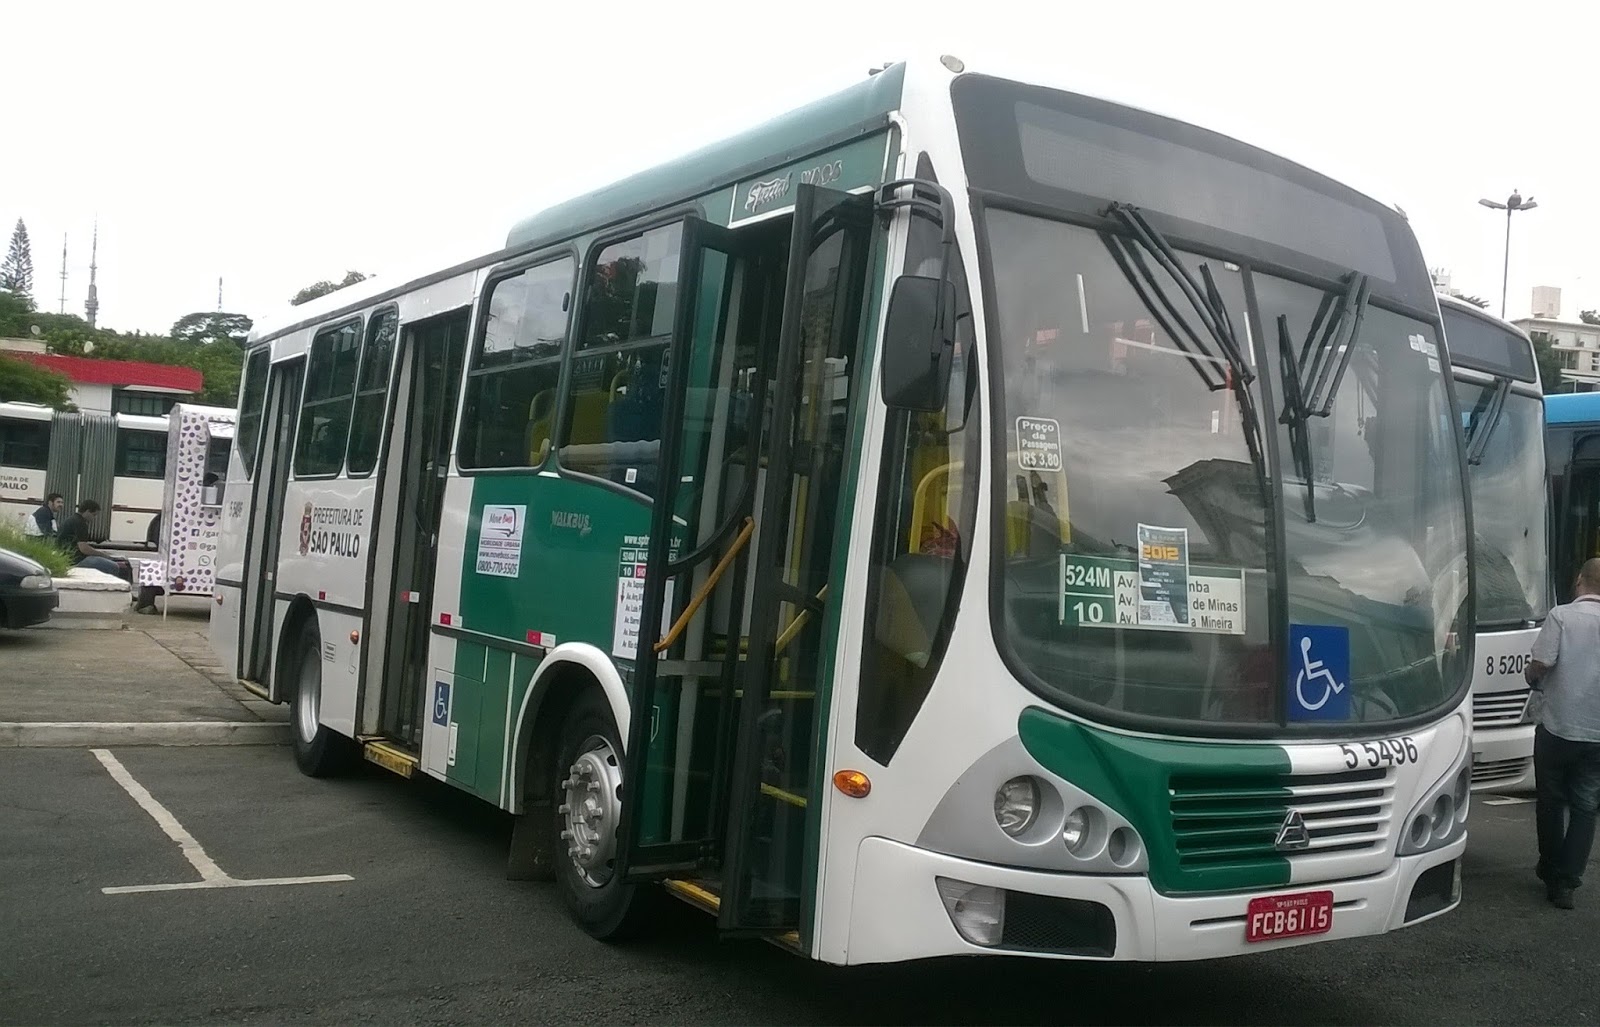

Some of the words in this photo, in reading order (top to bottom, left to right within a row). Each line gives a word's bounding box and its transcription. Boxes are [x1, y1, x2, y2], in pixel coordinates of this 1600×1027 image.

[1022, 420, 1054, 433] Preço
[1021, 438, 1058, 451] Passagem
[1022, 451, 1037, 467] R$
[1039, 452, 1059, 468] 3,80
[312, 506, 351, 526] PREFEITURA
[353, 508, 363, 526] DE
[311, 526, 328, 554] SÃO
[329, 532, 360, 558] PAULO
[1143, 544, 1179, 560] 2012
[623, 567, 632, 577] 10
[1065, 565, 1110, 588] 524M
[1117, 575, 1136, 589] Av.
[1118, 593, 1135, 607] Av.
[1192, 600, 1206, 611] de
[1208, 601, 1238, 613] Minas
[1073, 601, 1104, 624] 10
[1201, 616, 1233, 630] Mineira
[1486, 655, 1495, 676] 8
[1499, 654, 1532, 675] 5205
[1339, 743, 1358, 769] 5
[1363, 736, 1418, 767] 5496
